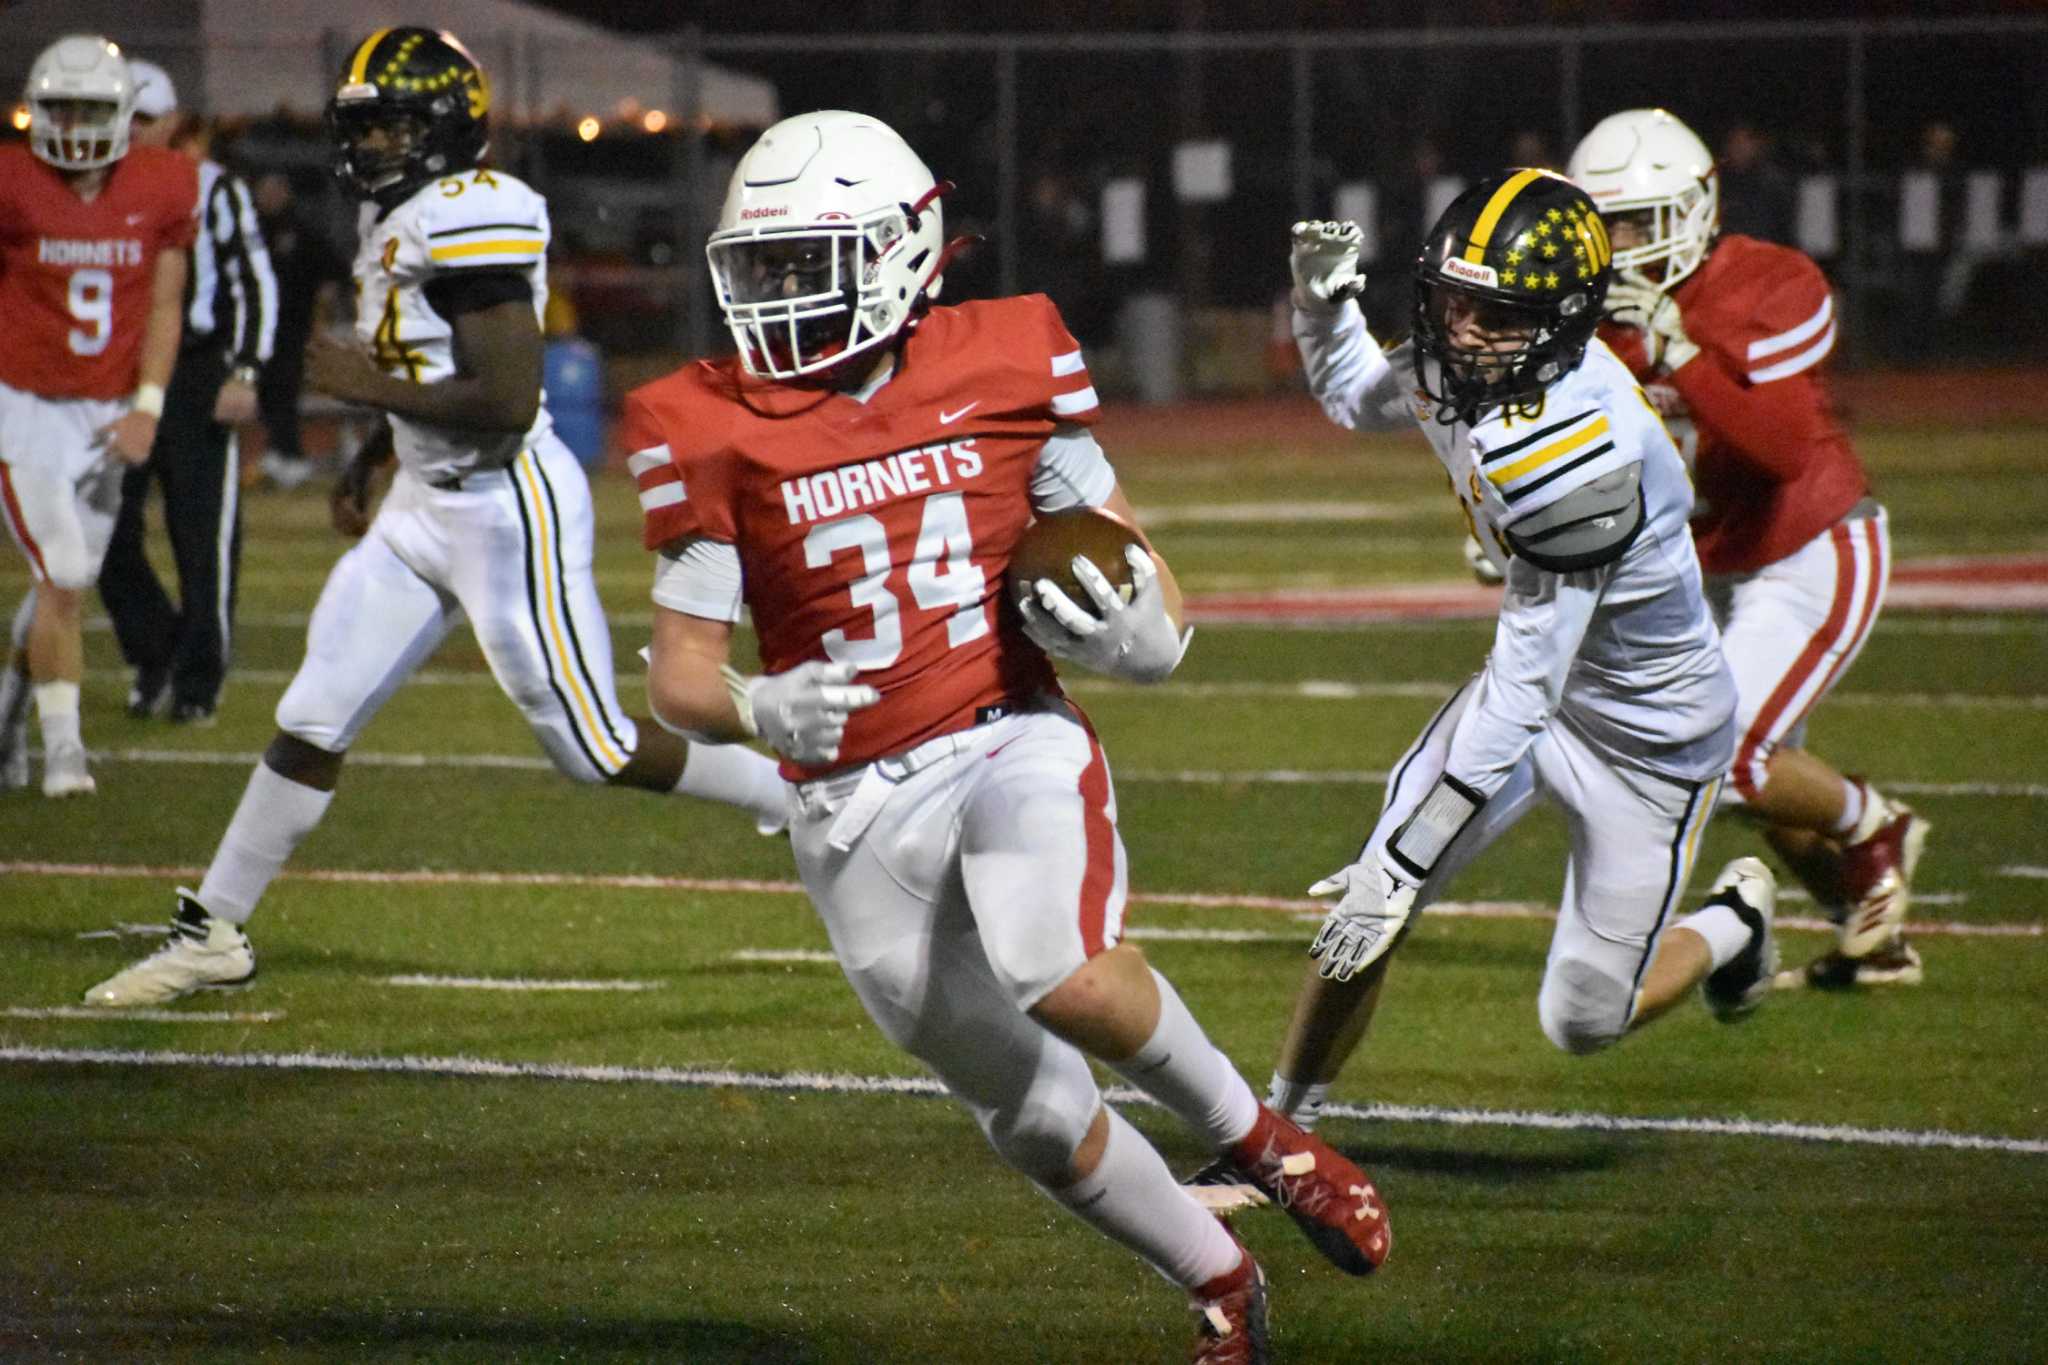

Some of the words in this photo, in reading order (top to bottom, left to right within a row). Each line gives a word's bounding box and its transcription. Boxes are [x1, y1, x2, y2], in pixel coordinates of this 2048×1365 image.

[68, 268, 113, 356] 9
[1447, 260, 1490, 281] Riddell
[780, 438, 984, 525] HORNETS
[803, 490, 990, 671] 34
